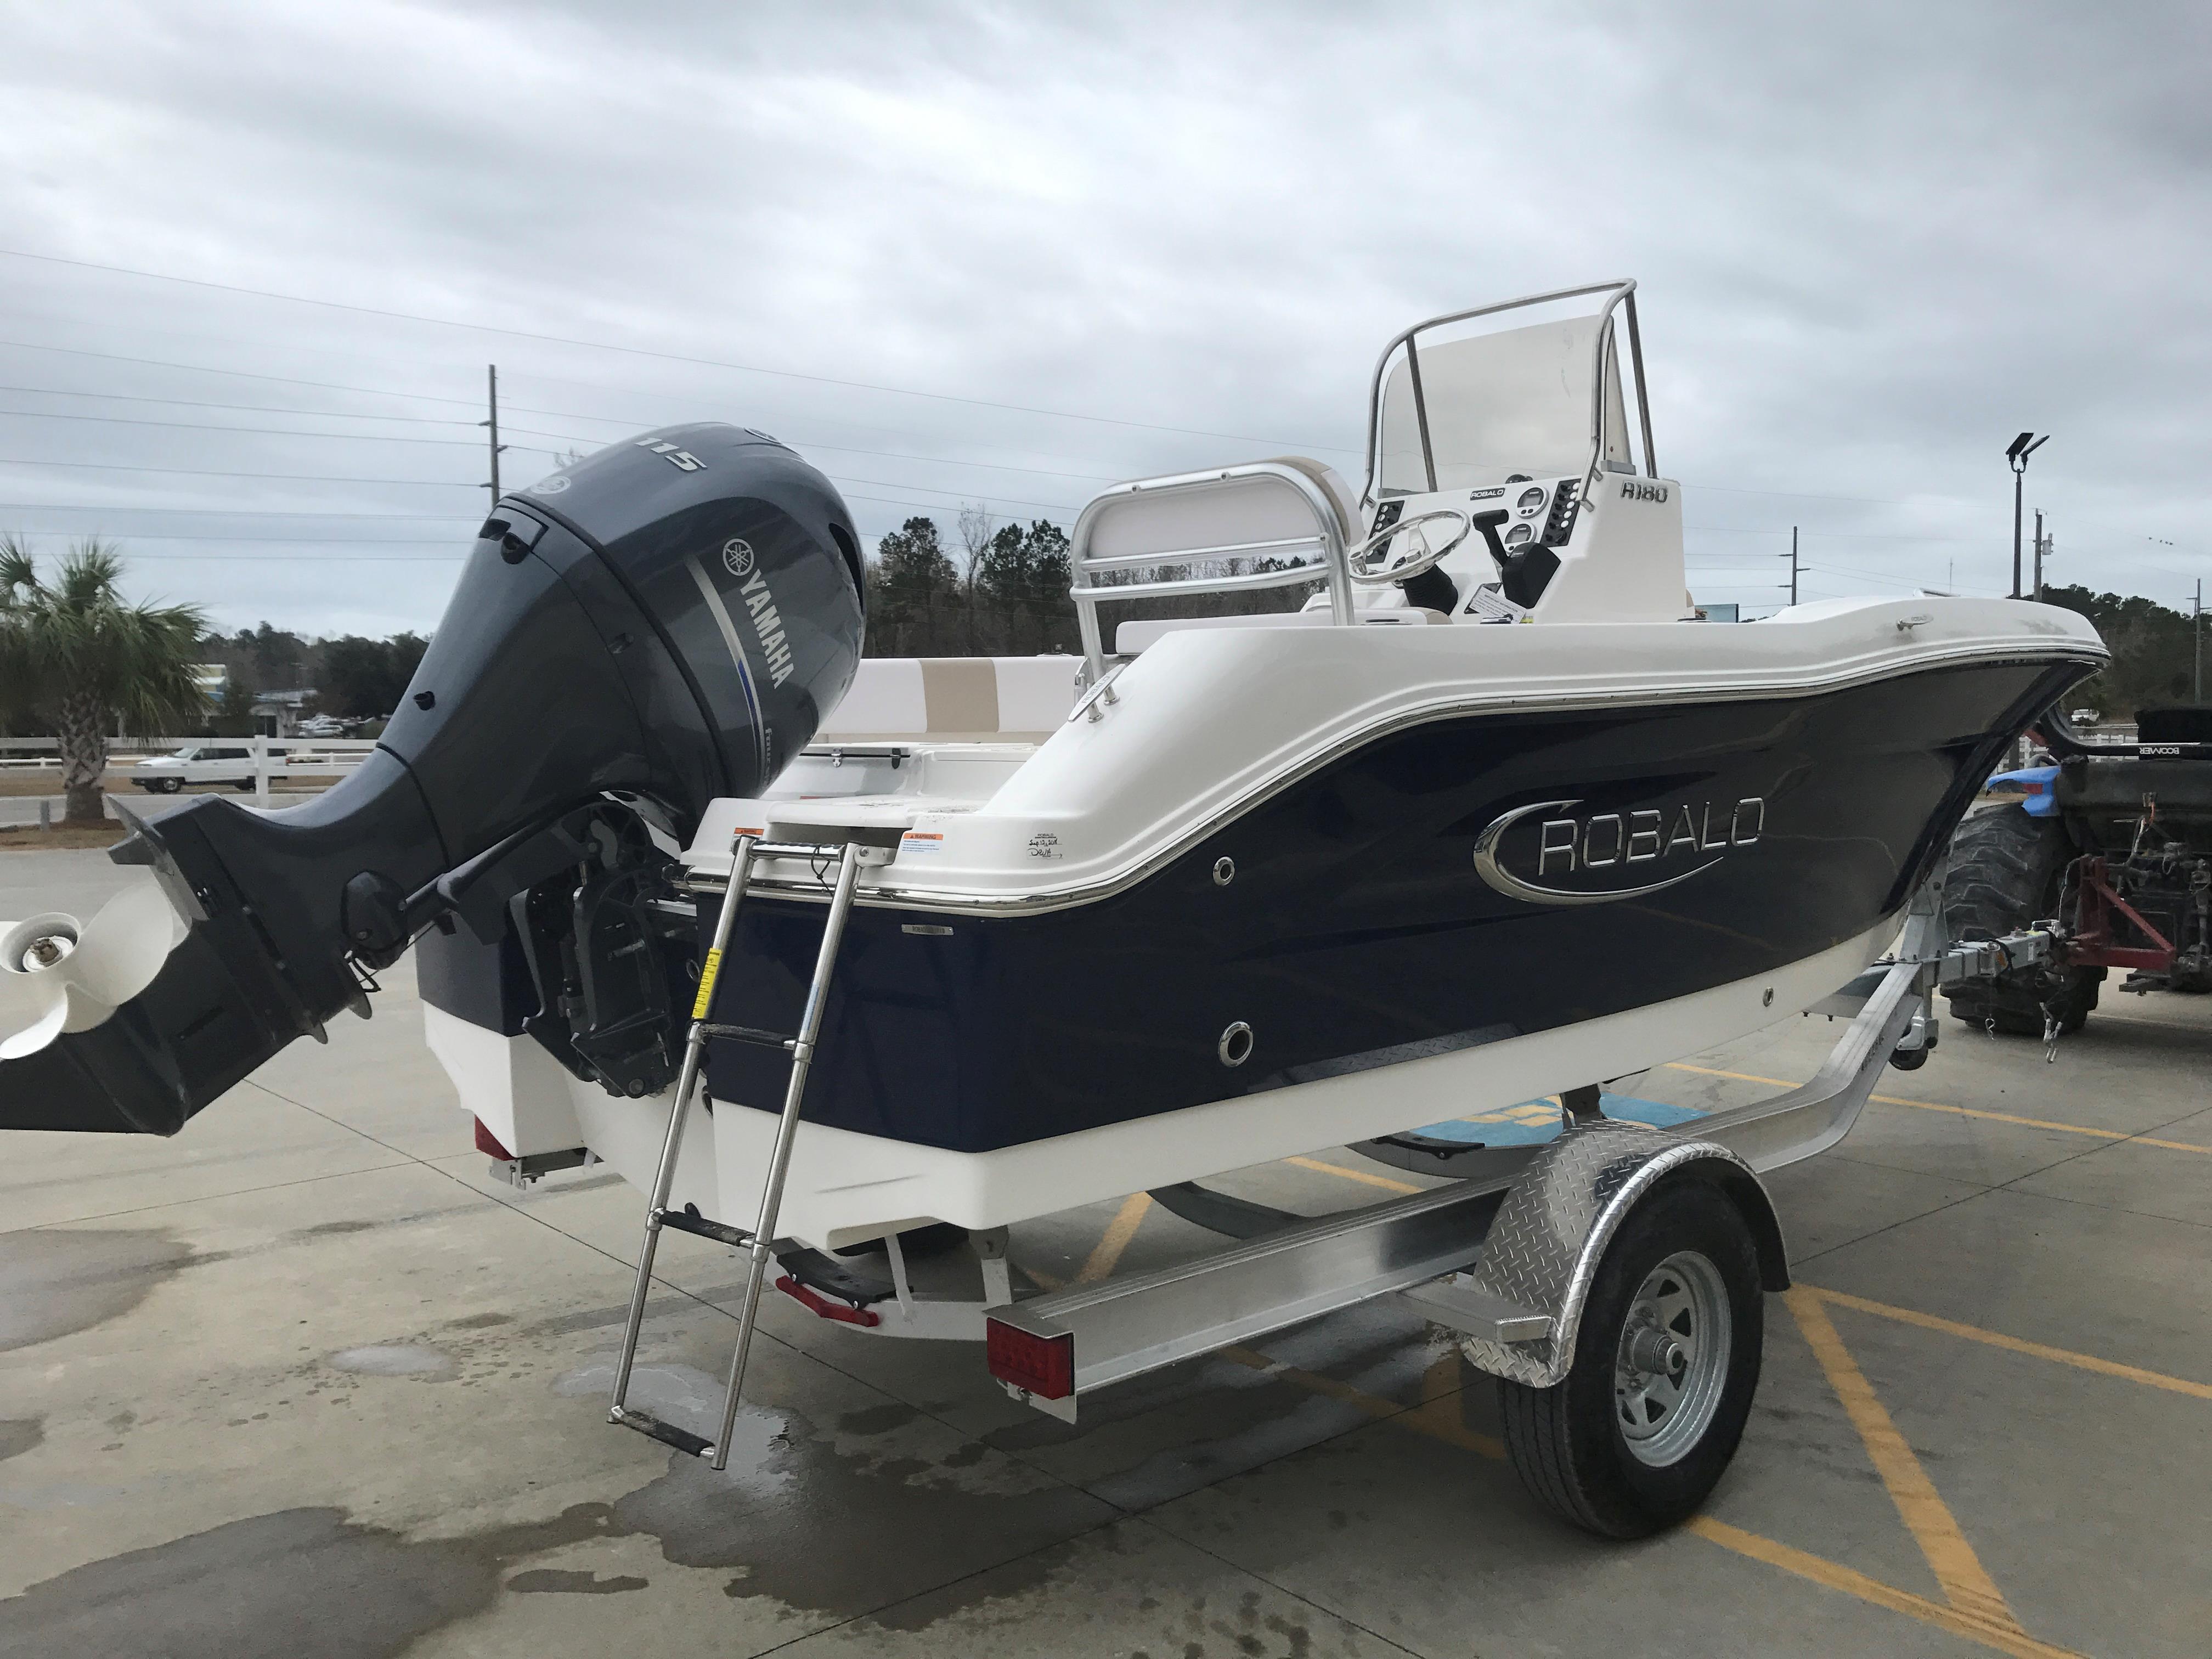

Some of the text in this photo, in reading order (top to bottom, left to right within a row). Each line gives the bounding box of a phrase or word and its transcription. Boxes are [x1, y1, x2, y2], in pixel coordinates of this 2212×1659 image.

[635, 437, 707, 471] 115
[1470, 489, 1504, 499] ROBALO
[1620, 481, 1668, 503] R180
[741, 568, 794, 690] YAMAHA
[1081, 676, 1110, 703] ROBALO
[2139, 747, 2180, 755] BOOMER
[1538, 797, 1765, 876] ROBALO
